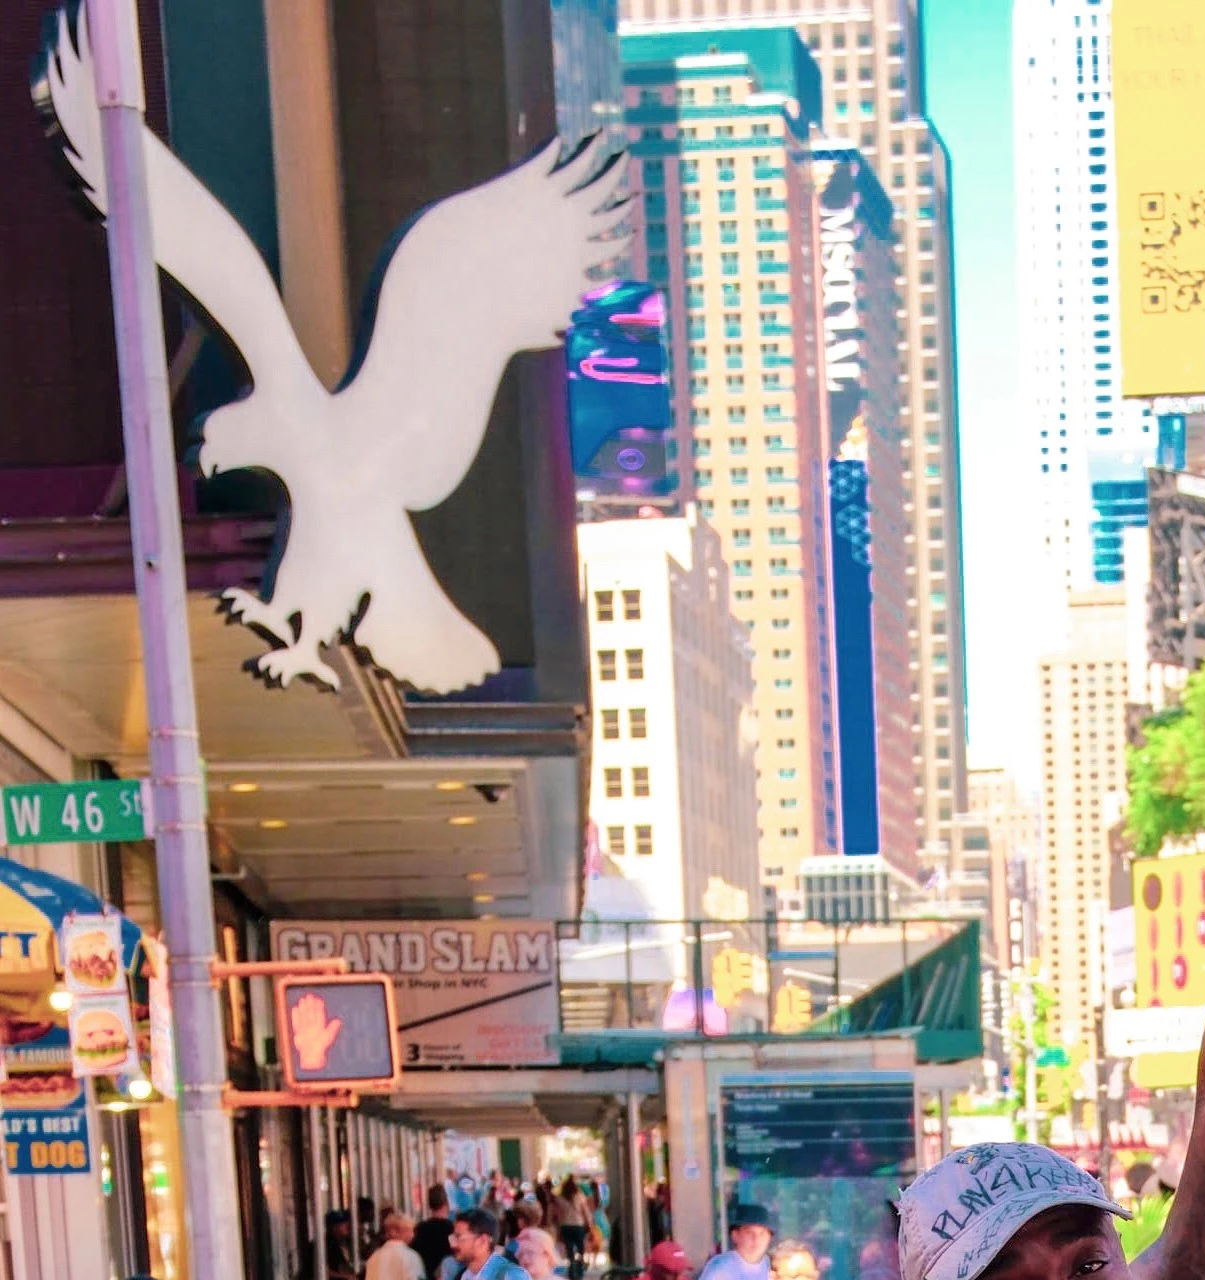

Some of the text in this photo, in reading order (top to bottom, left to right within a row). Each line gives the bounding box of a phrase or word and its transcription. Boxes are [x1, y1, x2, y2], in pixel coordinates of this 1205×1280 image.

[10, 795, 40, 837] W
[62, 791, 103, 833] 46
[278, 928, 427, 973] GRAND
[431, 928, 550, 973] SLAM
[408, 977, 441, 990] Shop
[444, 979, 457, 989] in
[461, 977, 488, 989] NYC
[407, 1043, 420, 1062] 3
[43, 1117, 80, 1134] BEST
[30, 1140, 87, 1169] DOG
[932, 1177, 996, 1240] PLAY
